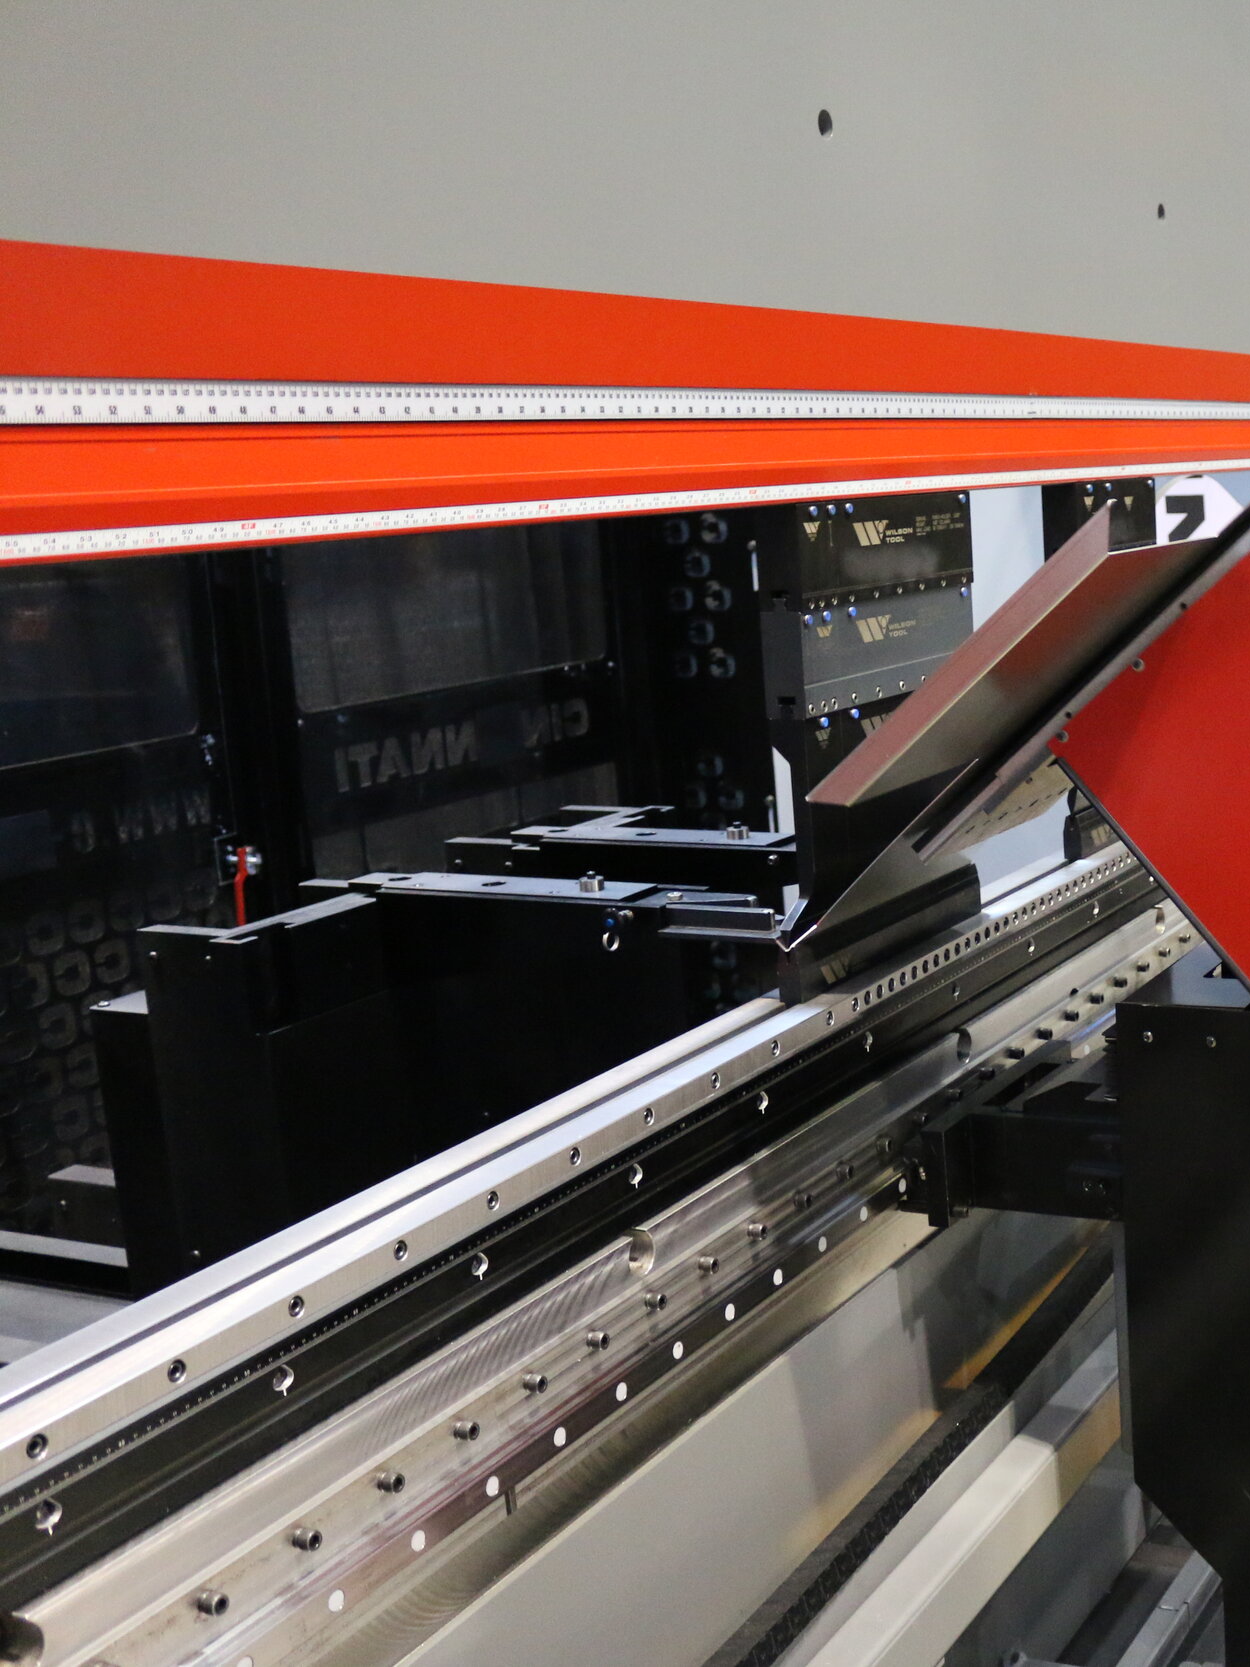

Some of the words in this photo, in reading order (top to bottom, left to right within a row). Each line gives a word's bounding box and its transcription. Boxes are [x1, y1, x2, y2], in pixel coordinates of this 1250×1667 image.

[73, 406, 81, 415] 53
[109, 406, 117, 415] 52
[885, 528, 913, 536] WILSON
